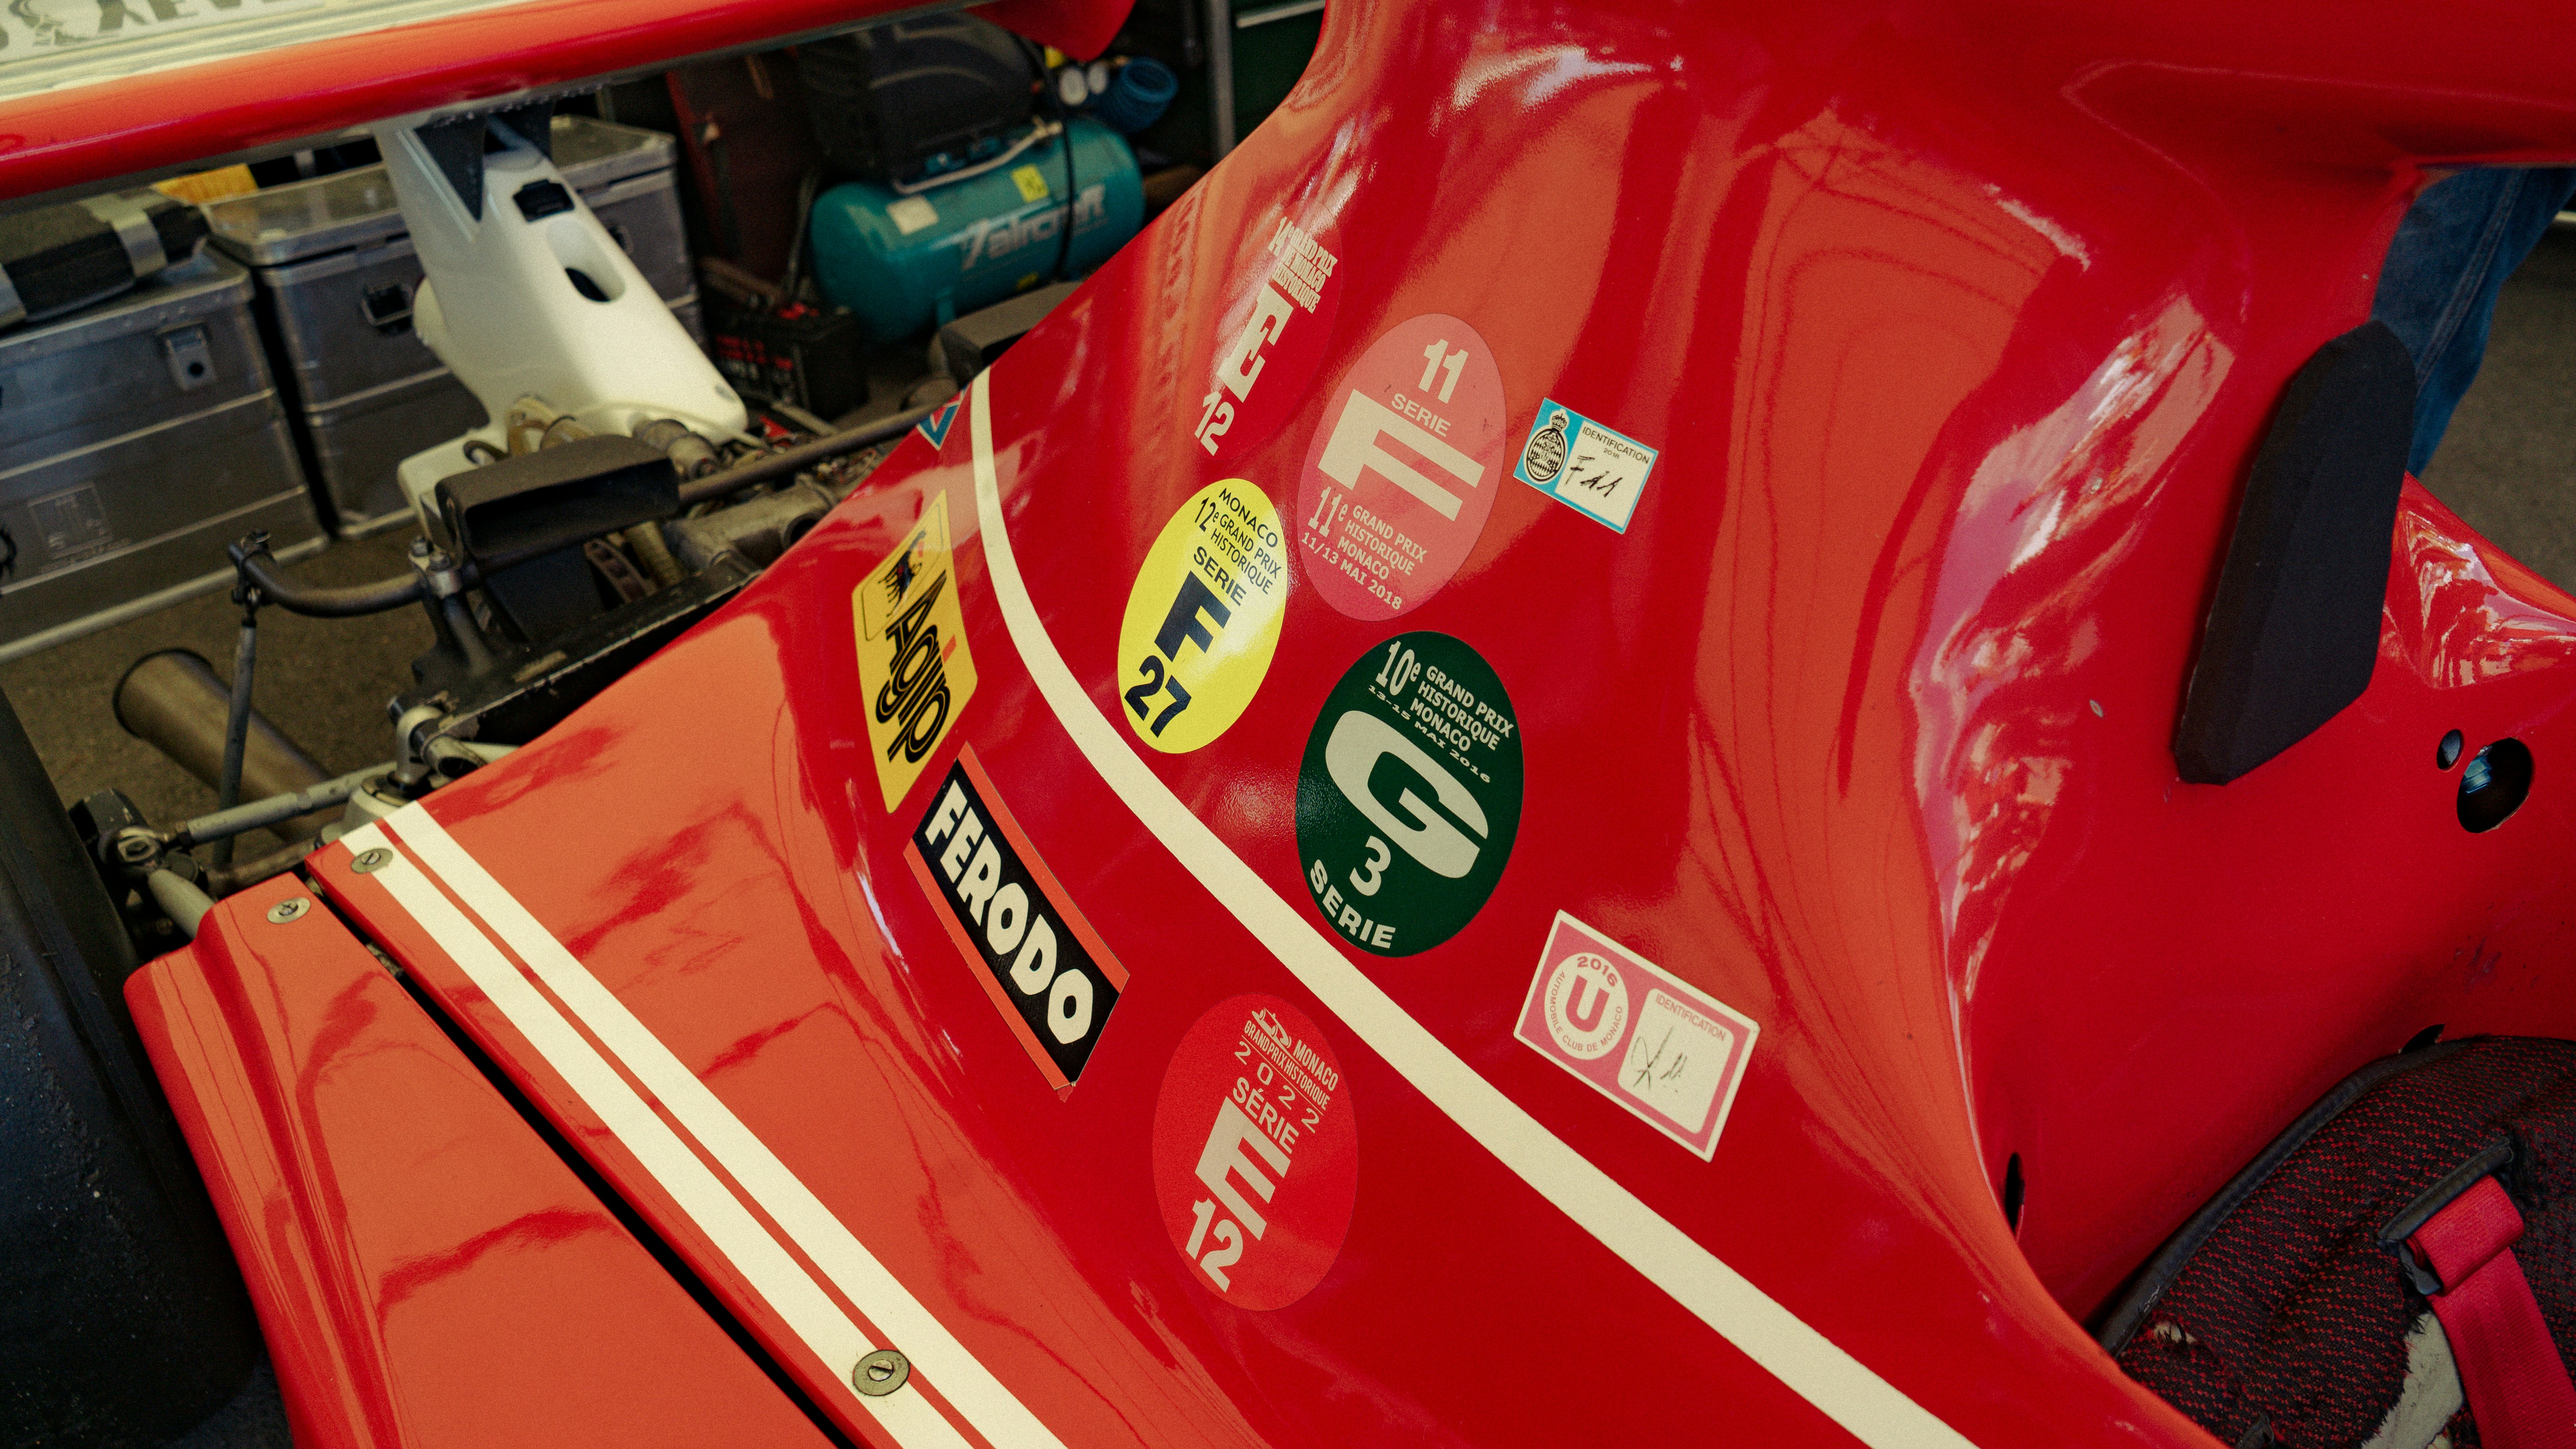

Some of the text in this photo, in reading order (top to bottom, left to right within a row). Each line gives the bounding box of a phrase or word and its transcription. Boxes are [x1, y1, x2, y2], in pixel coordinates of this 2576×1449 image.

[1281, 244, 1326, 292] DE MONACO
[1290, 228, 1318, 260] GRAND
[1312, 246, 1338, 277] PRIX
[1272, 262, 1321, 314] HISTORIQUE
[1217, 284, 1294, 403] E
[1419, 339, 1469, 404] 11
[1194, 391, 1234, 456] 12
[1391, 393, 1451, 437] SERIE
[1583, 426, 1650, 464] IDENTIFICATION
[1318, 389, 1485, 521] F
[1603, 448, 1619, 459] 2018
[1219, 488, 1278, 547] MONACO
[1220, 514, 1254, 552] GRAND
[1254, 547, 1282, 579] PRIX
[1345, 519, 1415, 576] HISTORIQUE
[1353, 505, 1394, 539] GRAND
[1394, 533, 1427, 563] PRIX
[1194, 546, 1247, 607] SERIE
[1211, 528, 1273, 595] HISTORIQUE
[1301, 532, 1402, 610] 11/13 MAI 2018
[1337, 536, 1389, 580] MONACO
[1154, 570, 1231, 662] F
[875, 570, 956, 764] Agip
[1124, 655, 1192, 738] 27
[1368, 685, 1490, 783] 13-15 MAI 2016
[1410, 698, 1470, 751] MONACO
[1418, 680, 1500, 751] HISTORIQUE
[1427, 666, 1474, 708] GRAND
[1475, 701, 1514, 738] PRIX
[1325, 710, 1488, 878] G
[1349, 835, 1391, 896] 3
[924, 779, 1093, 1044] FERODO
[1310, 859, 1396, 949] SERIE
[1566, 974, 1610, 1033] U
[1577, 956, 1618, 987] 2016
[1550, 971, 1622, 1052] AUTOMOBILE CLUB DE MONACO
[1656, 994, 1726, 1041] IDENTIFICATION
[1244, 1020, 1331, 1110] GRAND PRIX HISTORIQUE
[1293, 1039, 1339, 1091] MONACO
[1233, 1077, 1299, 1154] SÉRIE
[1194, 1096, 1291, 1241] E
[1185, 1198, 1243, 1293] 12
